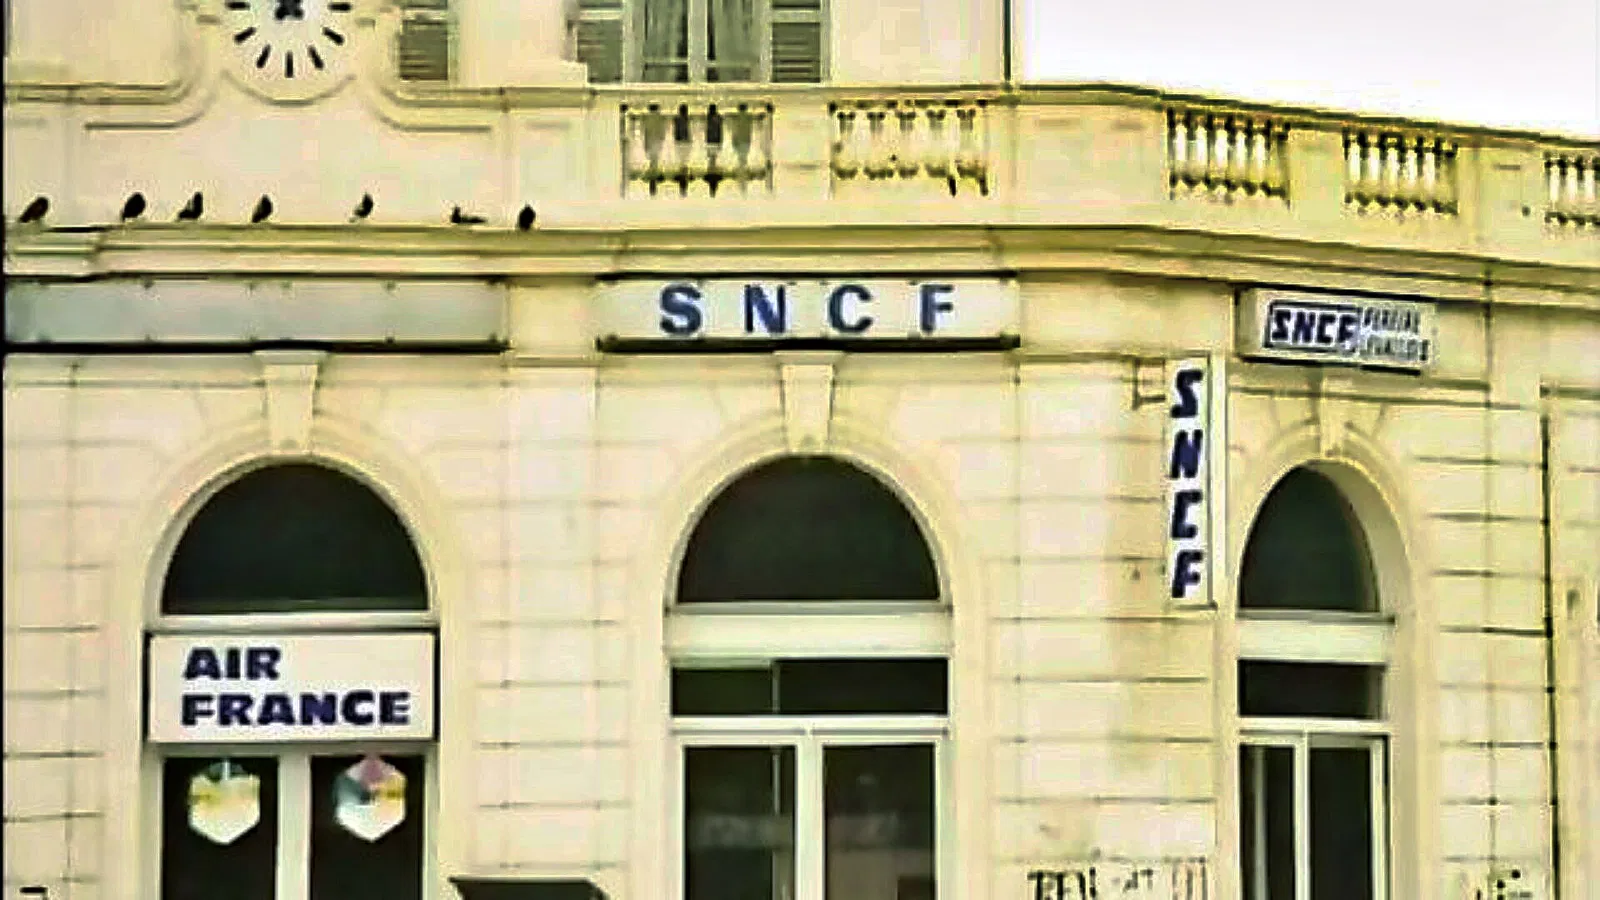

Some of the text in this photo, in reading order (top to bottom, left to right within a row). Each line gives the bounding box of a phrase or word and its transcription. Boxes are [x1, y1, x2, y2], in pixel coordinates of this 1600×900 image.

[659, 283, 955, 335] SNCF
[1270, 308, 1358, 345] SNCF
[1170, 369, 1204, 599] SNCF
[184, 646, 282, 681] AIR
[180, 690, 410, 727] FRANCE
